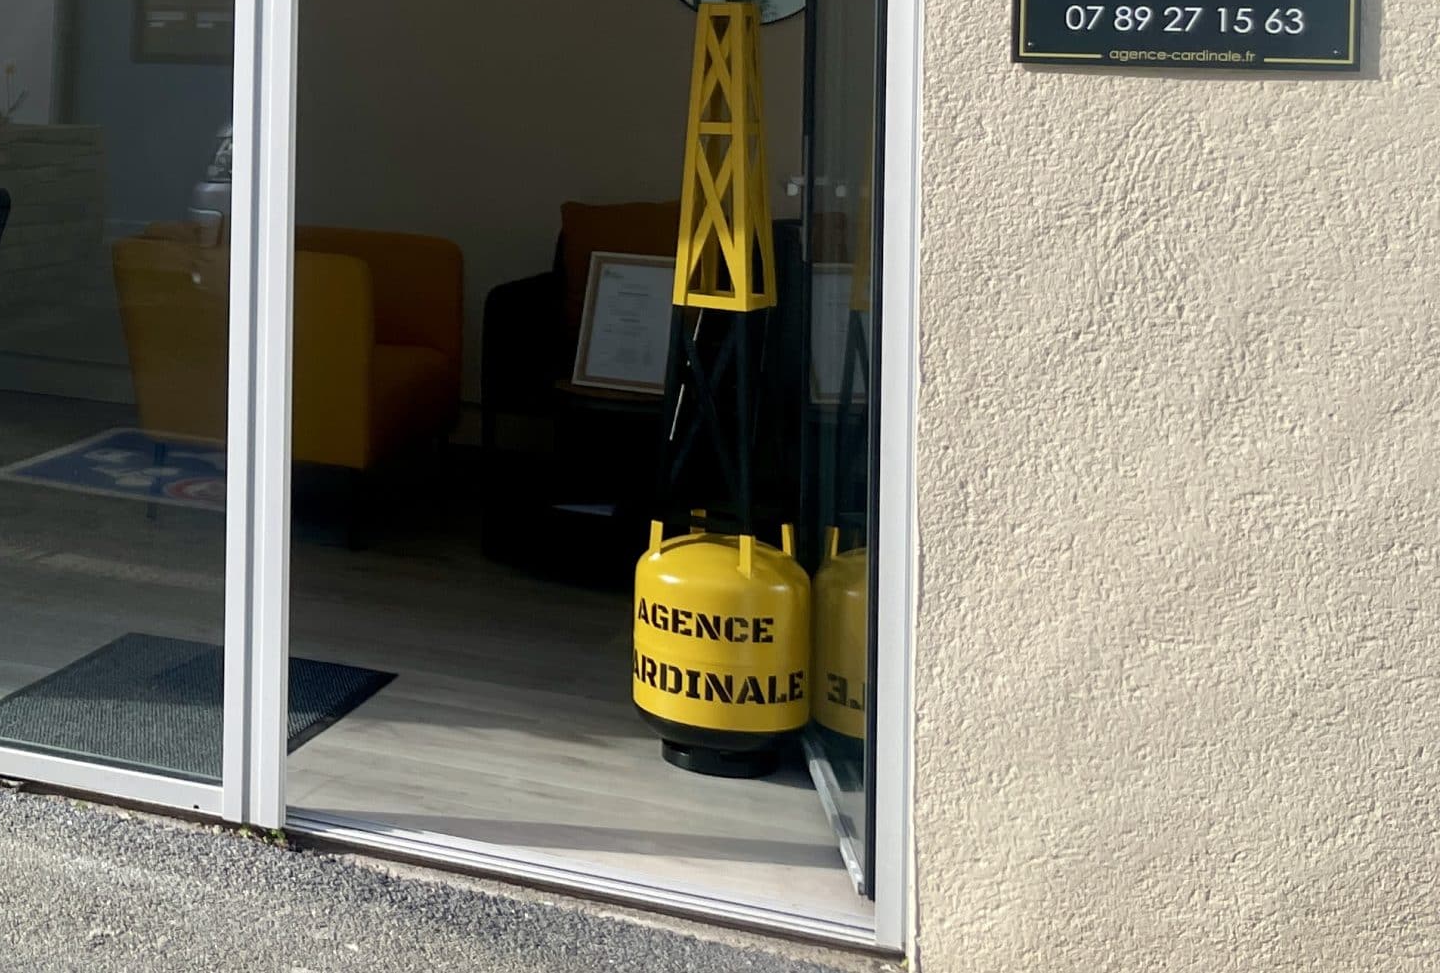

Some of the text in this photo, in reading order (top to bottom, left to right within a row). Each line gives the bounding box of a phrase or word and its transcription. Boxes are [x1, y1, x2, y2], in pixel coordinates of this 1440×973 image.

[1065, 4, 1305, 35] 07 89 27 15 63
[1108, 49, 1257, 64] agence-cardinale.fr
[638, 596, 775, 643] AGENCE
